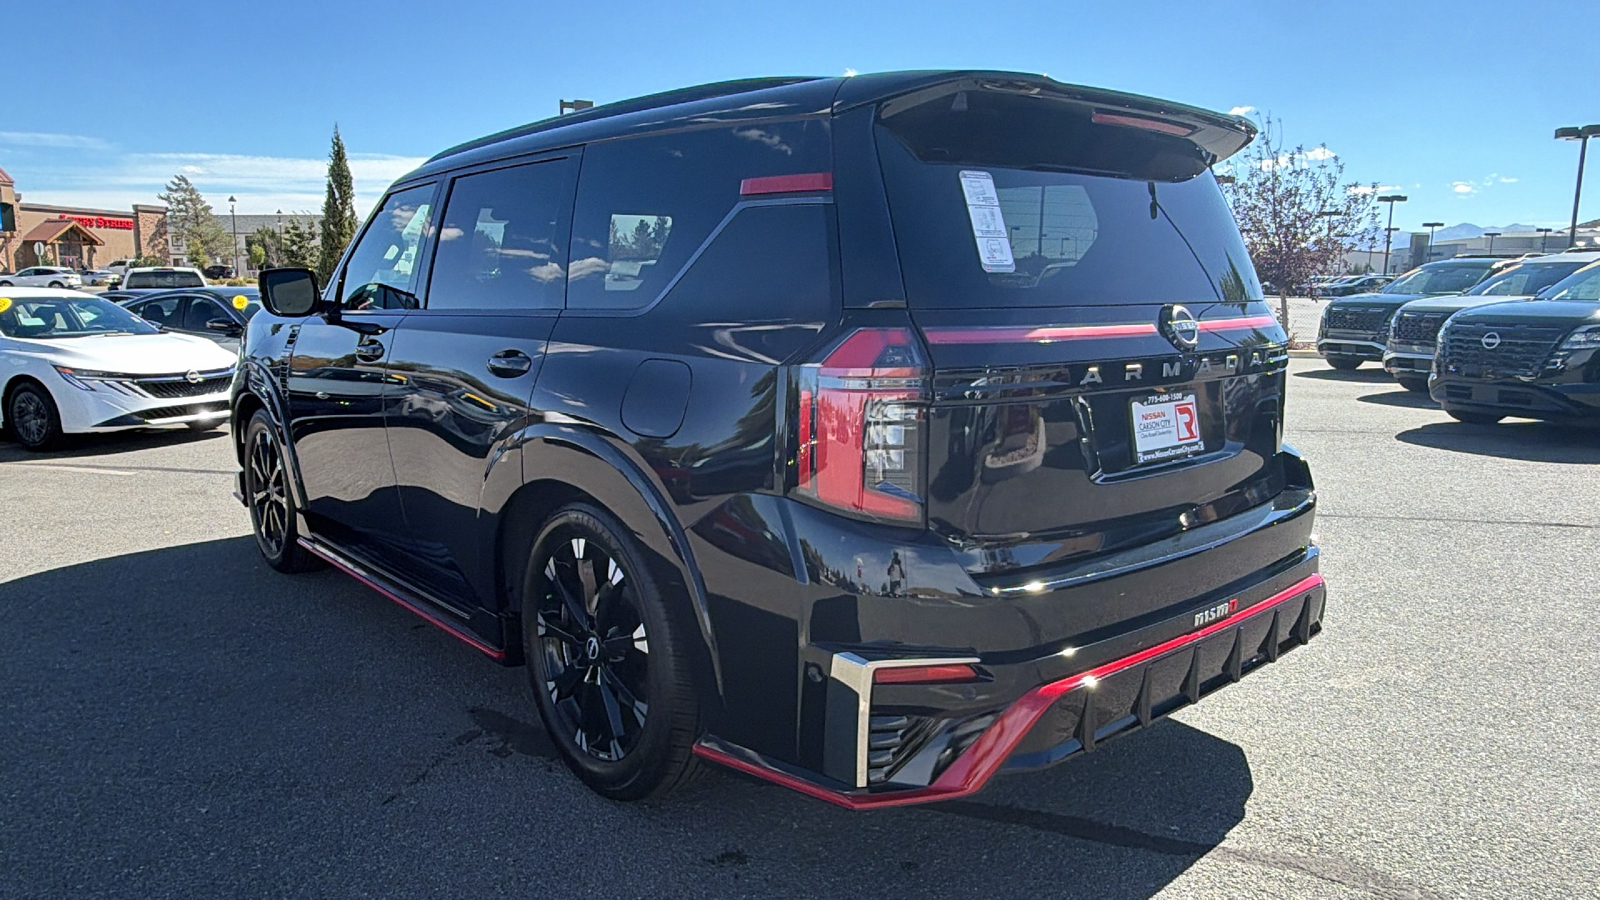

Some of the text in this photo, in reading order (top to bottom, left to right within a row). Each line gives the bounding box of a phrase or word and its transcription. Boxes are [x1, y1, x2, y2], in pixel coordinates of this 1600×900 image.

[1079, 353, 1262, 385] ARMADA
[1141, 411, 1166, 420] NISSAN
[1139, 419, 1171, 430] CARSON CITY
